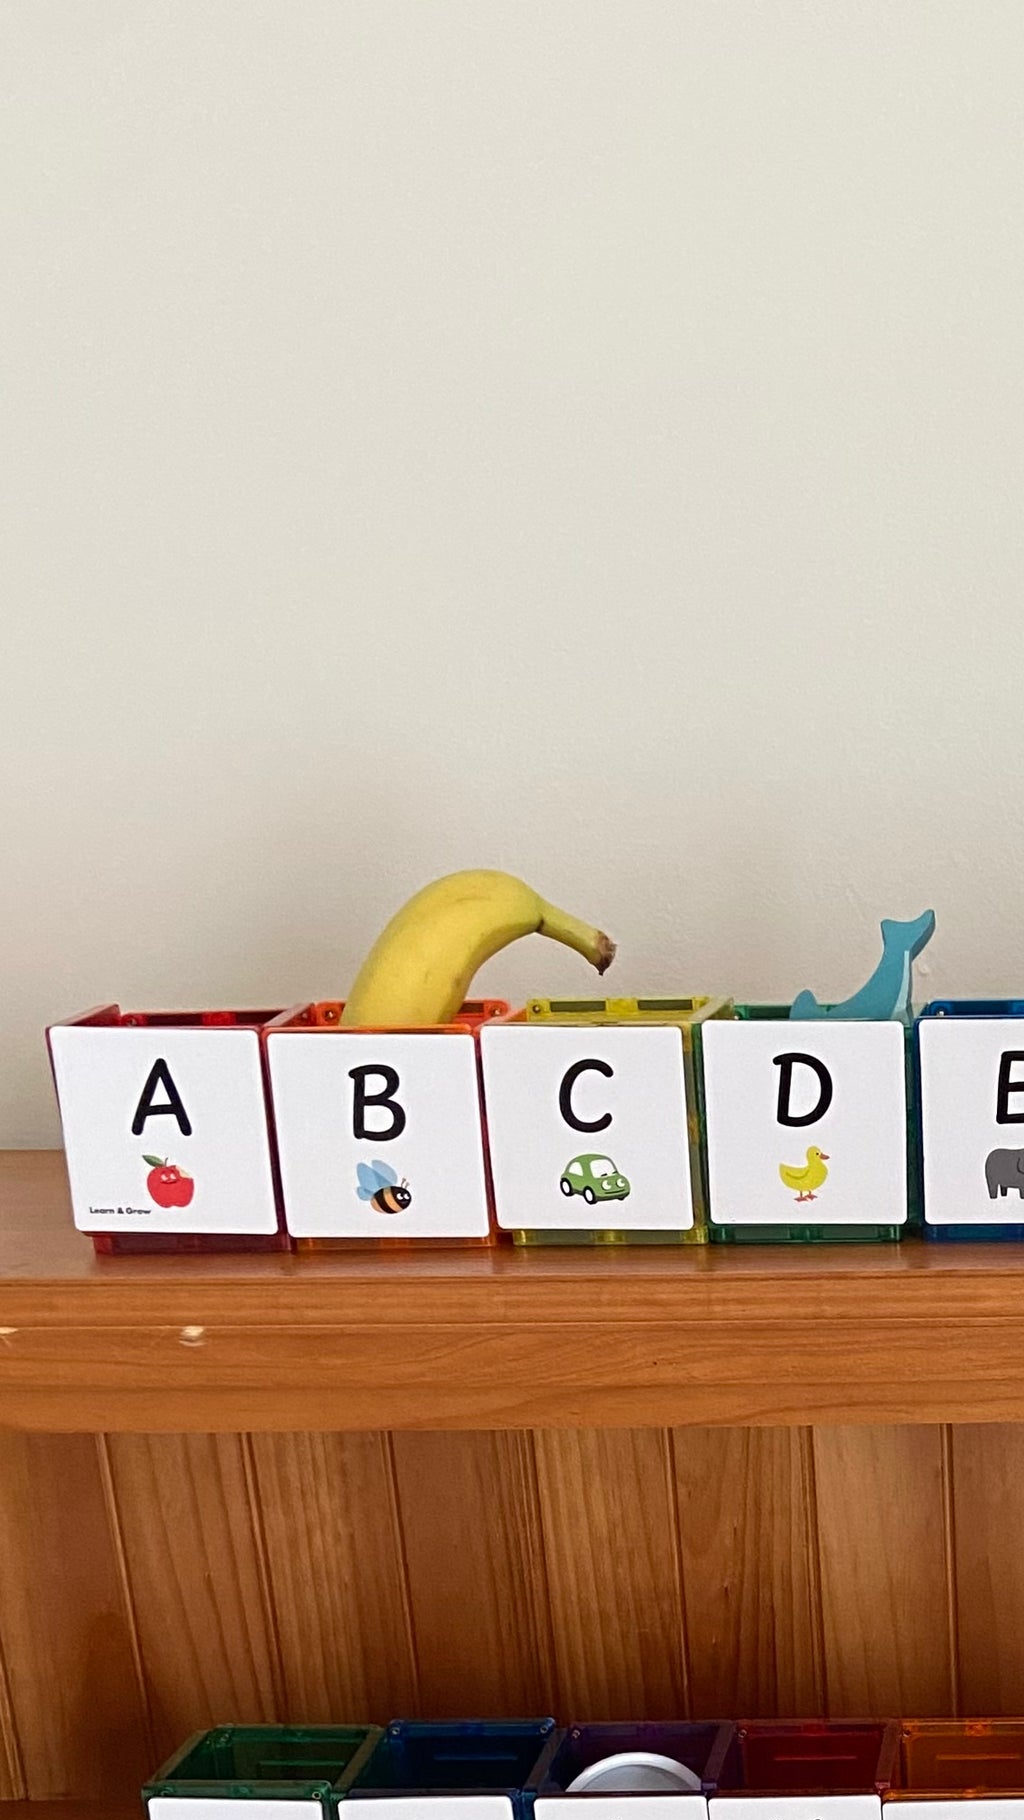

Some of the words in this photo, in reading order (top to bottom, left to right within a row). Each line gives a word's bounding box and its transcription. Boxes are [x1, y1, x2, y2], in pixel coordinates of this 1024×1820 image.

[131, 1057, 193, 1137] A
[347, 1063, 407, 1142] B
[558, 1058, 614, 1134] C
[772, 1052, 833, 1128] D
[89, 1206, 115, 1214] Learn
[126, 1207, 152, 1215] Grow
